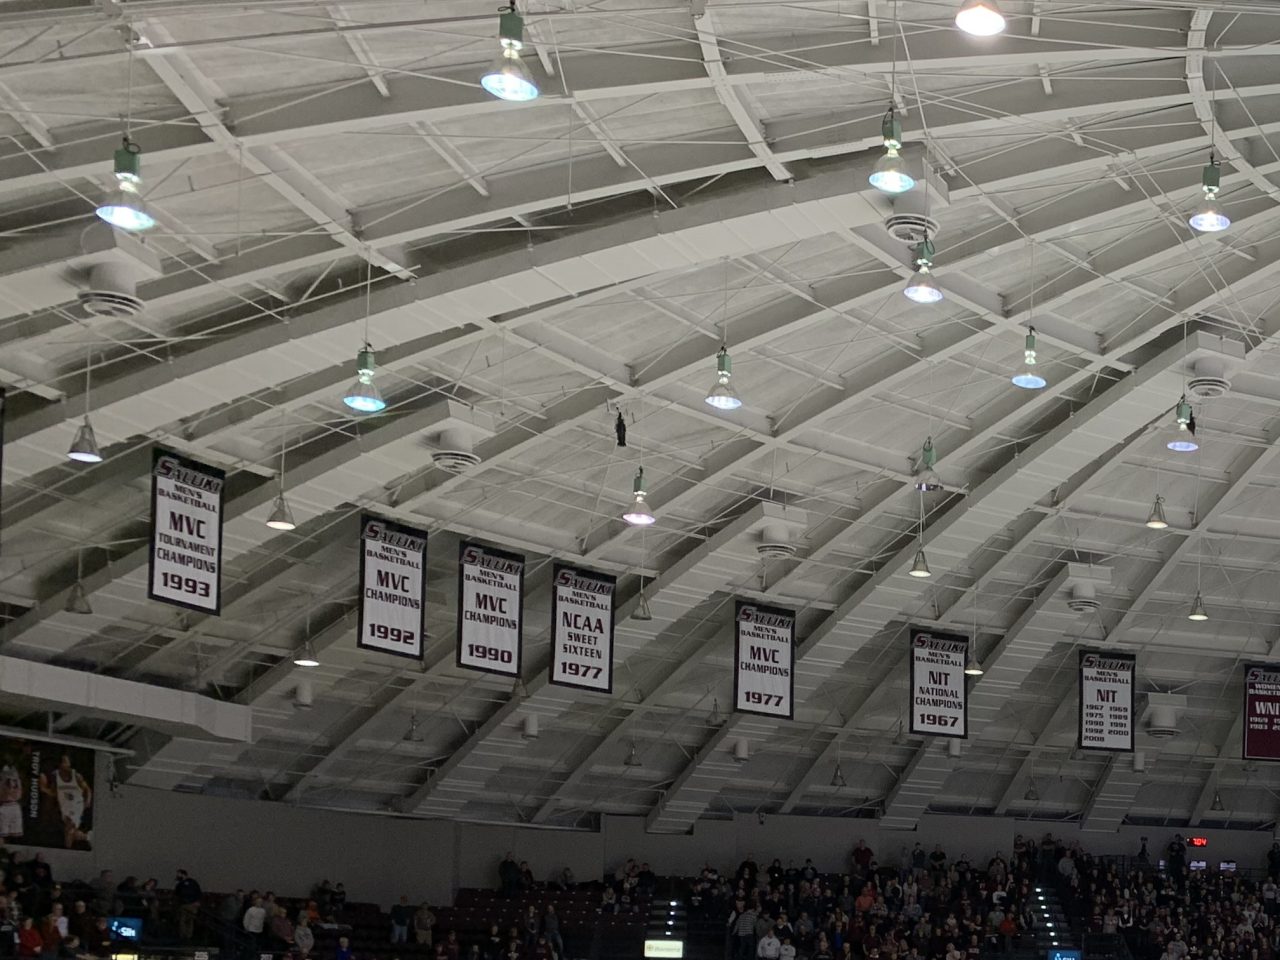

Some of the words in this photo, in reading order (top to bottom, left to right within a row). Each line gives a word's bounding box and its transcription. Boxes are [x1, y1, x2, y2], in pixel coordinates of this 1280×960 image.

[174, 484, 202, 499] MEN'S
[158, 488, 217, 513] BASKETBALL
[169, 511, 206, 539] MVC
[159, 532, 215, 557] TOURNAMENT
[381, 545, 408, 558] MEN'S
[157, 547, 215, 574] CHAMPIONS
[367, 549, 420, 569] BASKETBALL
[377, 569, 409, 593] MVC
[465, 574, 517, 591] BASKETBALL
[479, 569, 504, 581] MEN'S
[162, 572, 210, 597] 1993
[366, 588, 420, 609] CHAMPIONS
[475, 592, 507, 614] MVC
[558, 595, 609, 611] BASKETBALL
[572, 590, 597, 601] MEN'S
[465, 610, 517, 630] CHAMPIONS
[562, 611, 604, 634] NCAA
[369, 623, 414, 645] 1992
[741, 630, 789, 643] BASKETBALL
[753, 625, 777, 634] MEN'S
[567, 632, 598, 646] SWEET
[468, 644, 512, 664] 1990
[562, 643, 602, 659] SIXTEEN
[750, 645, 779, 664] MVC
[928, 651, 951, 659] MEN'S
[740, 661, 789, 677] CHAMPIONS
[915, 656, 962, 667] BASKETBALL
[561, 661, 603, 679] 1977
[928, 671, 950, 686] NIT
[1084, 676, 1130, 684] BASKETBALL
[744, 691, 784, 707] 1977
[919, 686, 959, 699] NATIONAL
[1096, 689, 1117, 703] NIT
[915, 697, 962, 710] CHAMPIONS
[920, 713, 959, 727] 1967
[30, 777, 39, 818] HUDSON
